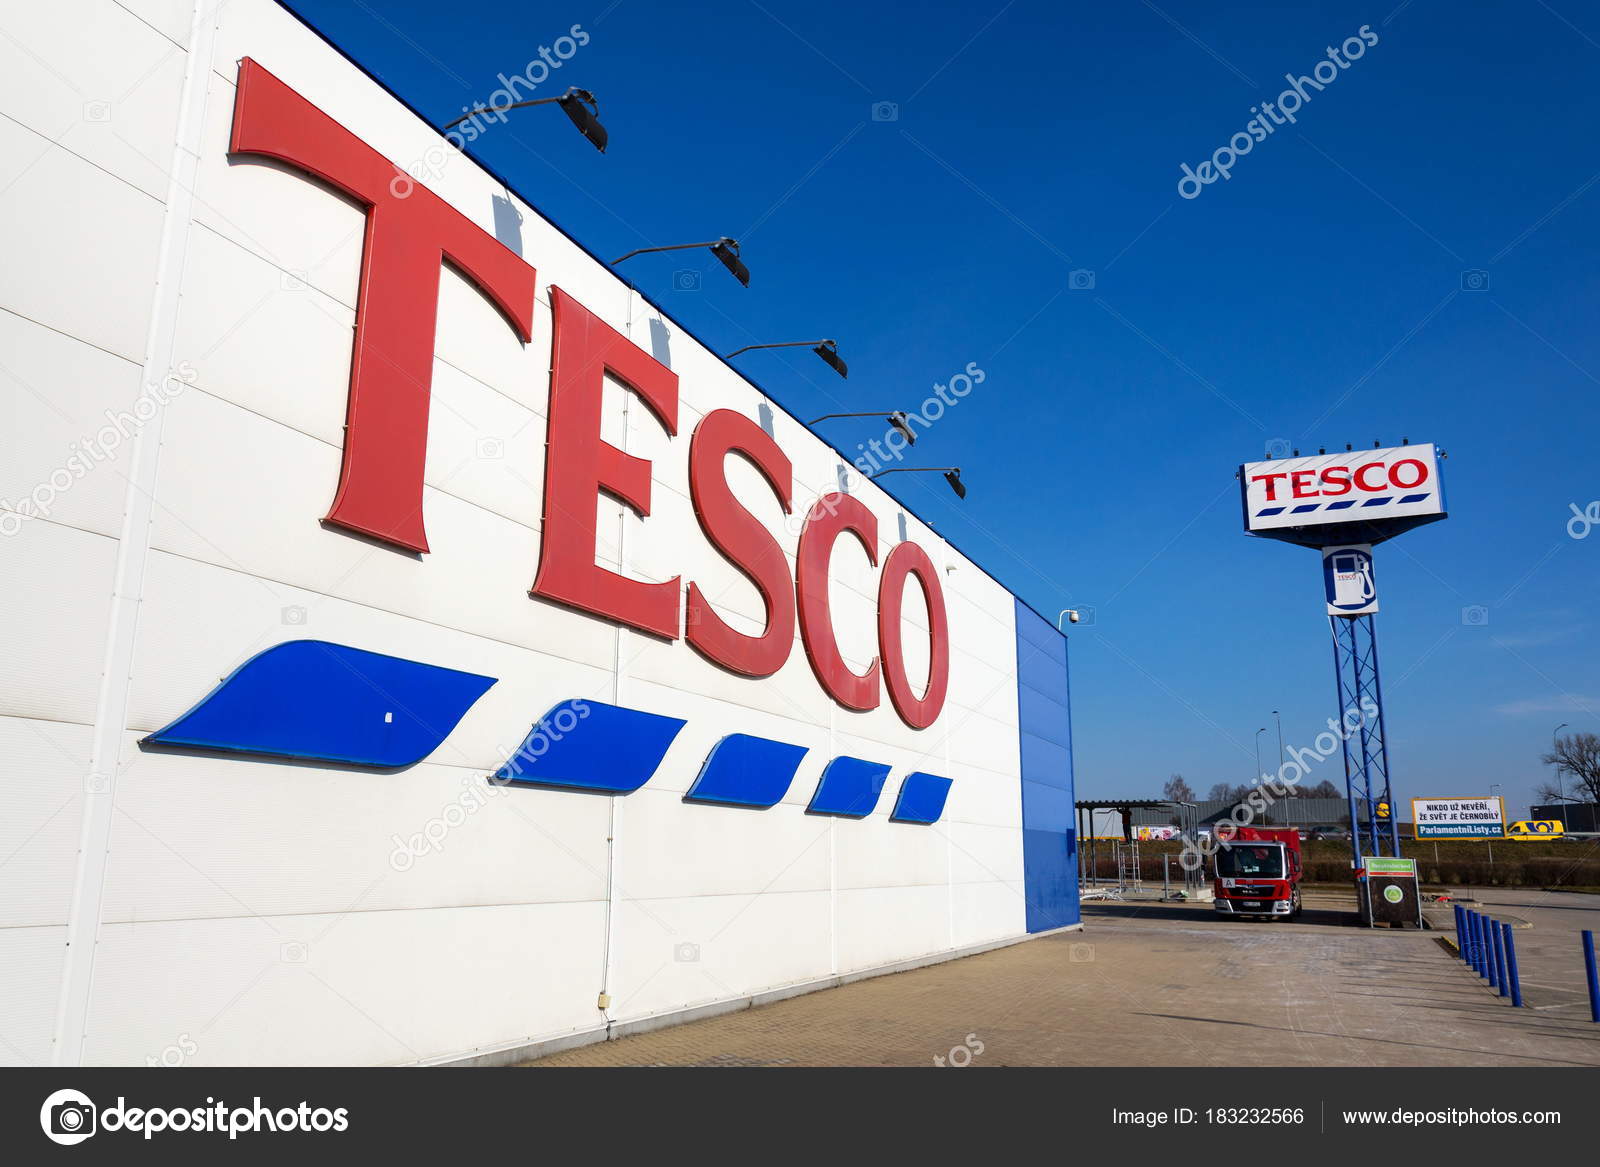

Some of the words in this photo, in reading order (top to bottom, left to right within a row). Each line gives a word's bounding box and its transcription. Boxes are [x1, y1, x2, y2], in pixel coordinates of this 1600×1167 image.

[229, 56, 950, 731] TESCO
[1252, 459, 1429, 502] TESCO
[1429, 812, 1447, 820] SVĚT
[1450, 803, 1460, 811] UŽ
